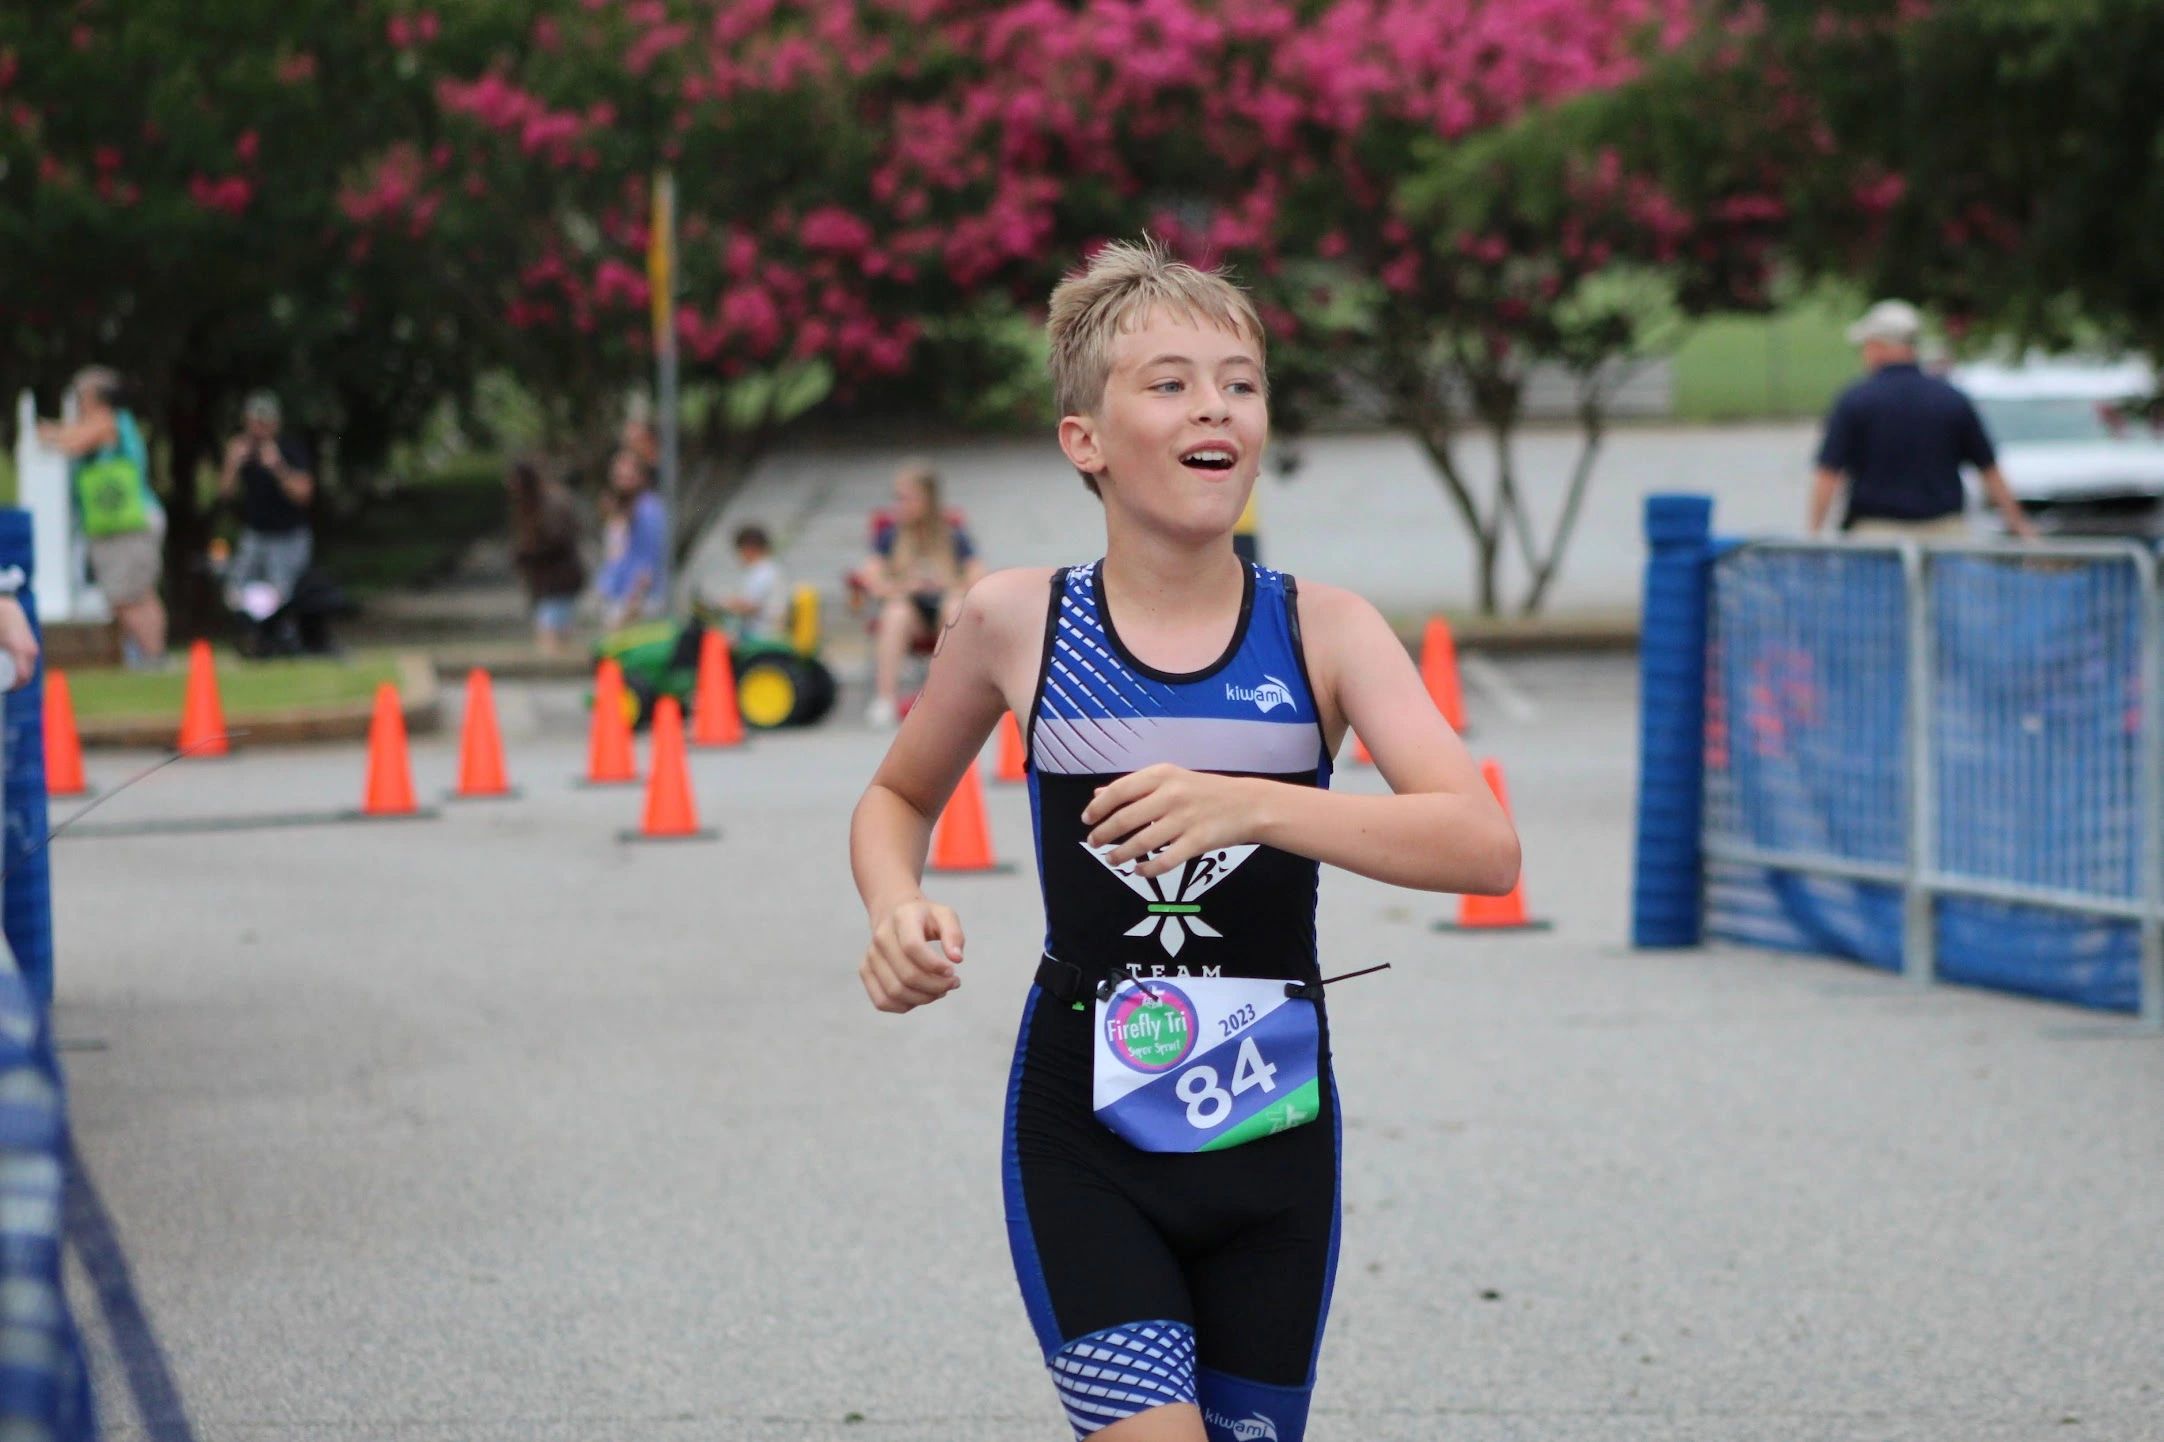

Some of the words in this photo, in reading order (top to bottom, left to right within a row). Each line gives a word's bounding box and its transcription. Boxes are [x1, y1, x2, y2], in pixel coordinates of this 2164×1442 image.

[1225, 682, 1284, 703] kiwami
[1126, 963, 1221, 978] TEAM
[1106, 1012, 1161, 1042] Firefly
[1164, 1010, 1187, 1033] Tri
[1218, 1003, 1257, 1037] 2023
[1175, 1036, 1277, 1129] 84
[1204, 1407, 1268, 1438] kiwami
